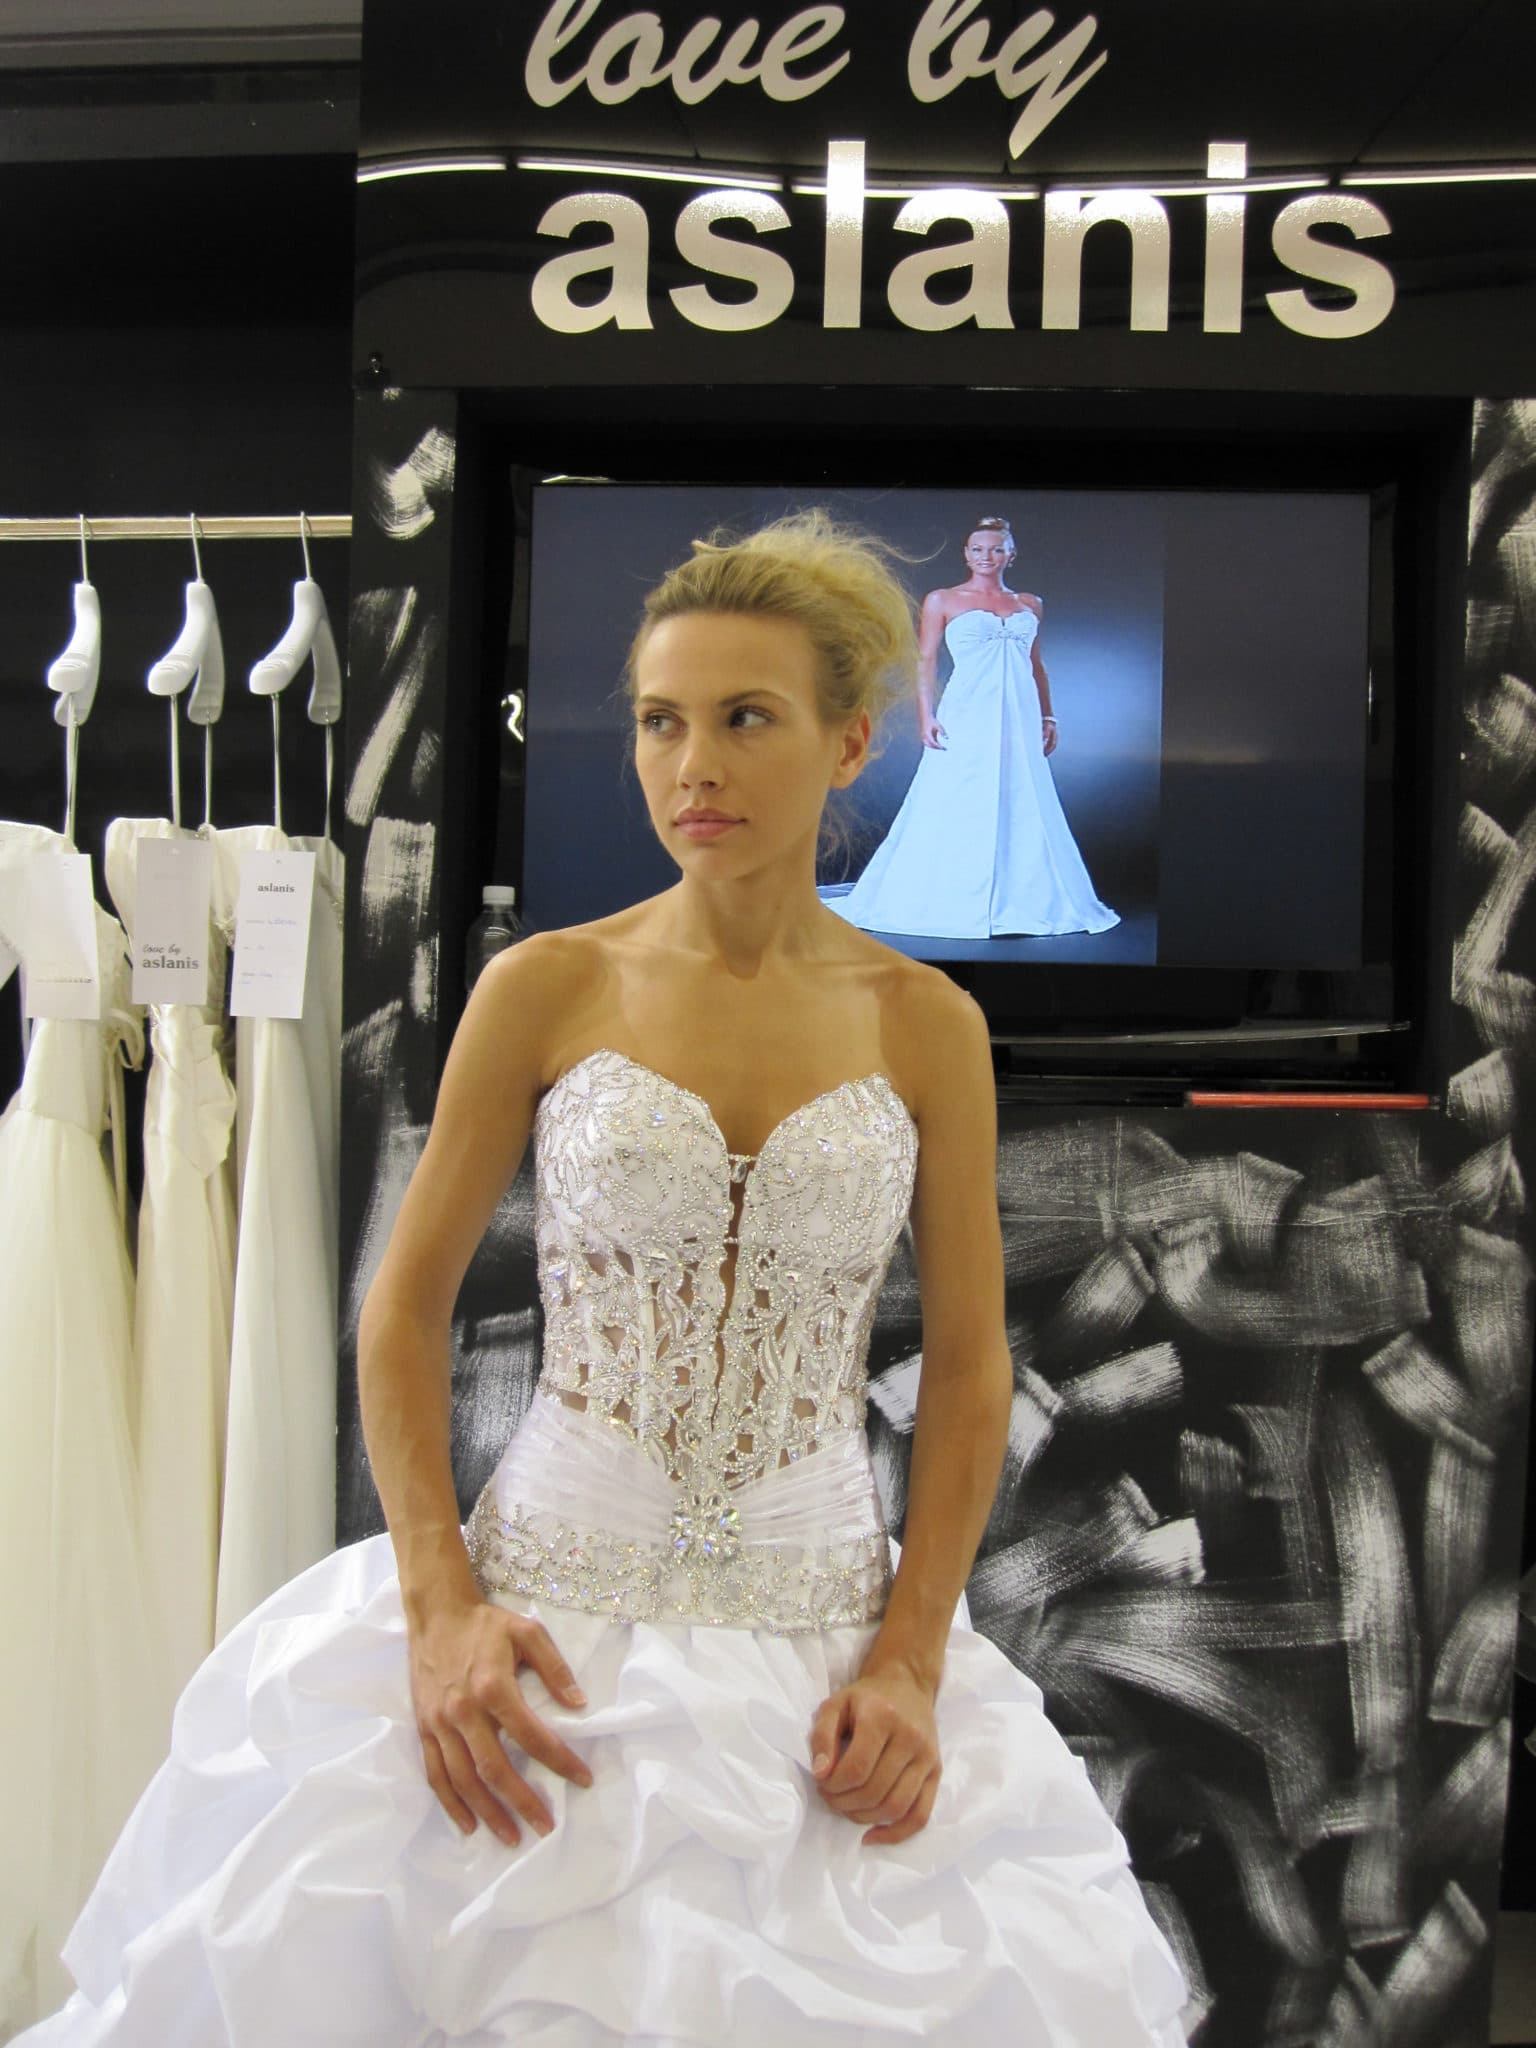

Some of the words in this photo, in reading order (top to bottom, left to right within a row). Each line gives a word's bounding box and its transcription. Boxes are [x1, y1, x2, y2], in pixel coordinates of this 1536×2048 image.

[525, 0, 850, 107] love
[907, 0, 1108, 160] by
[531, 140, 1396, 339] aslanis
[257, 883, 296, 894] aslanis
[143, 955, 200, 970] aslanis
